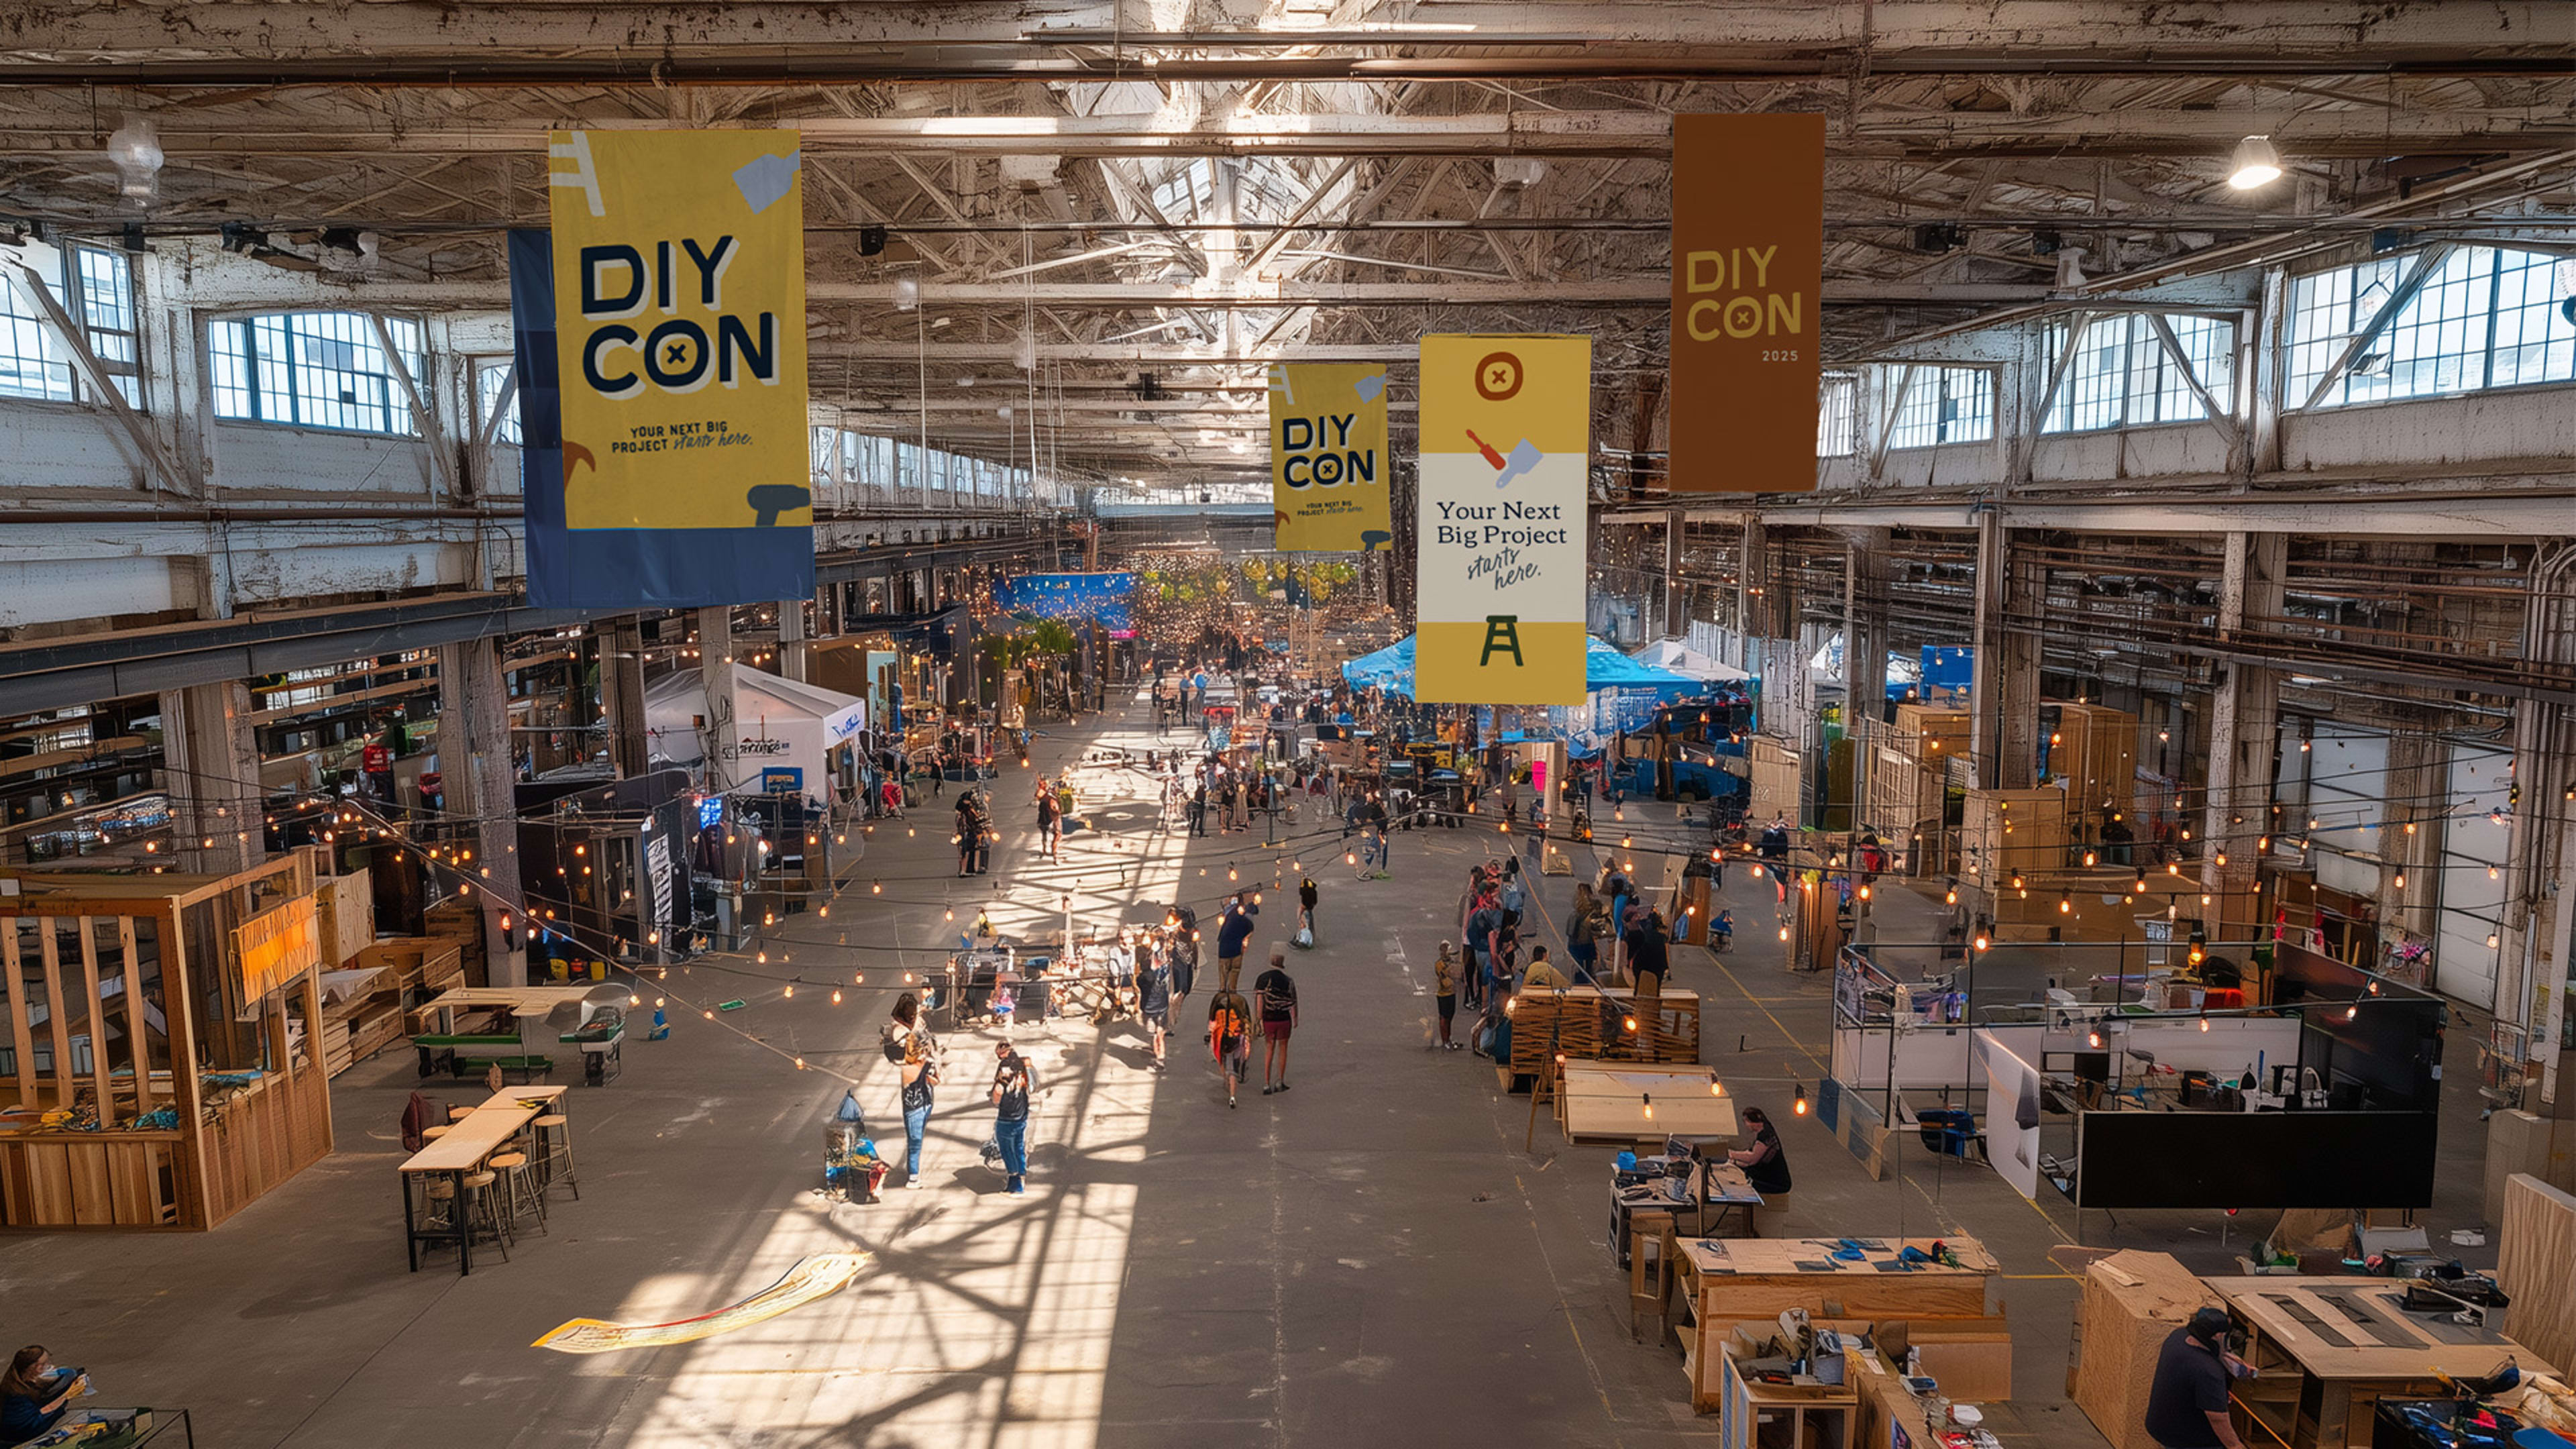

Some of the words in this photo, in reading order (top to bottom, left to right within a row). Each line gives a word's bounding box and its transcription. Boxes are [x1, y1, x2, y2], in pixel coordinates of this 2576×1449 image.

[580, 235, 740, 320] DIY
[1686, 245, 1778, 294] DIY
[1686, 292, 1802, 341] CON
[582, 312, 780, 400] CON
[1762, 350, 1799, 362] 2025
[612, 438, 669, 453] PROJECT
[673, 434, 715, 450] starts
[717, 431, 754, 447] here.
[631, 425, 665, 439] YOUR
[669, 422, 702, 435] NEXT
[706, 421, 729, 433] BIG
[1283, 413, 1358, 454] DIY
[1283, 449, 1377, 492] CON
[1436, 500, 1497, 520] Your
[1503, 500, 1561, 520] Next
[1437, 525, 1478, 549] Big
[1483, 525, 1568, 547] Project
[1467, 546, 1521, 580] starts
[1494, 562, 1542, 591] here.
